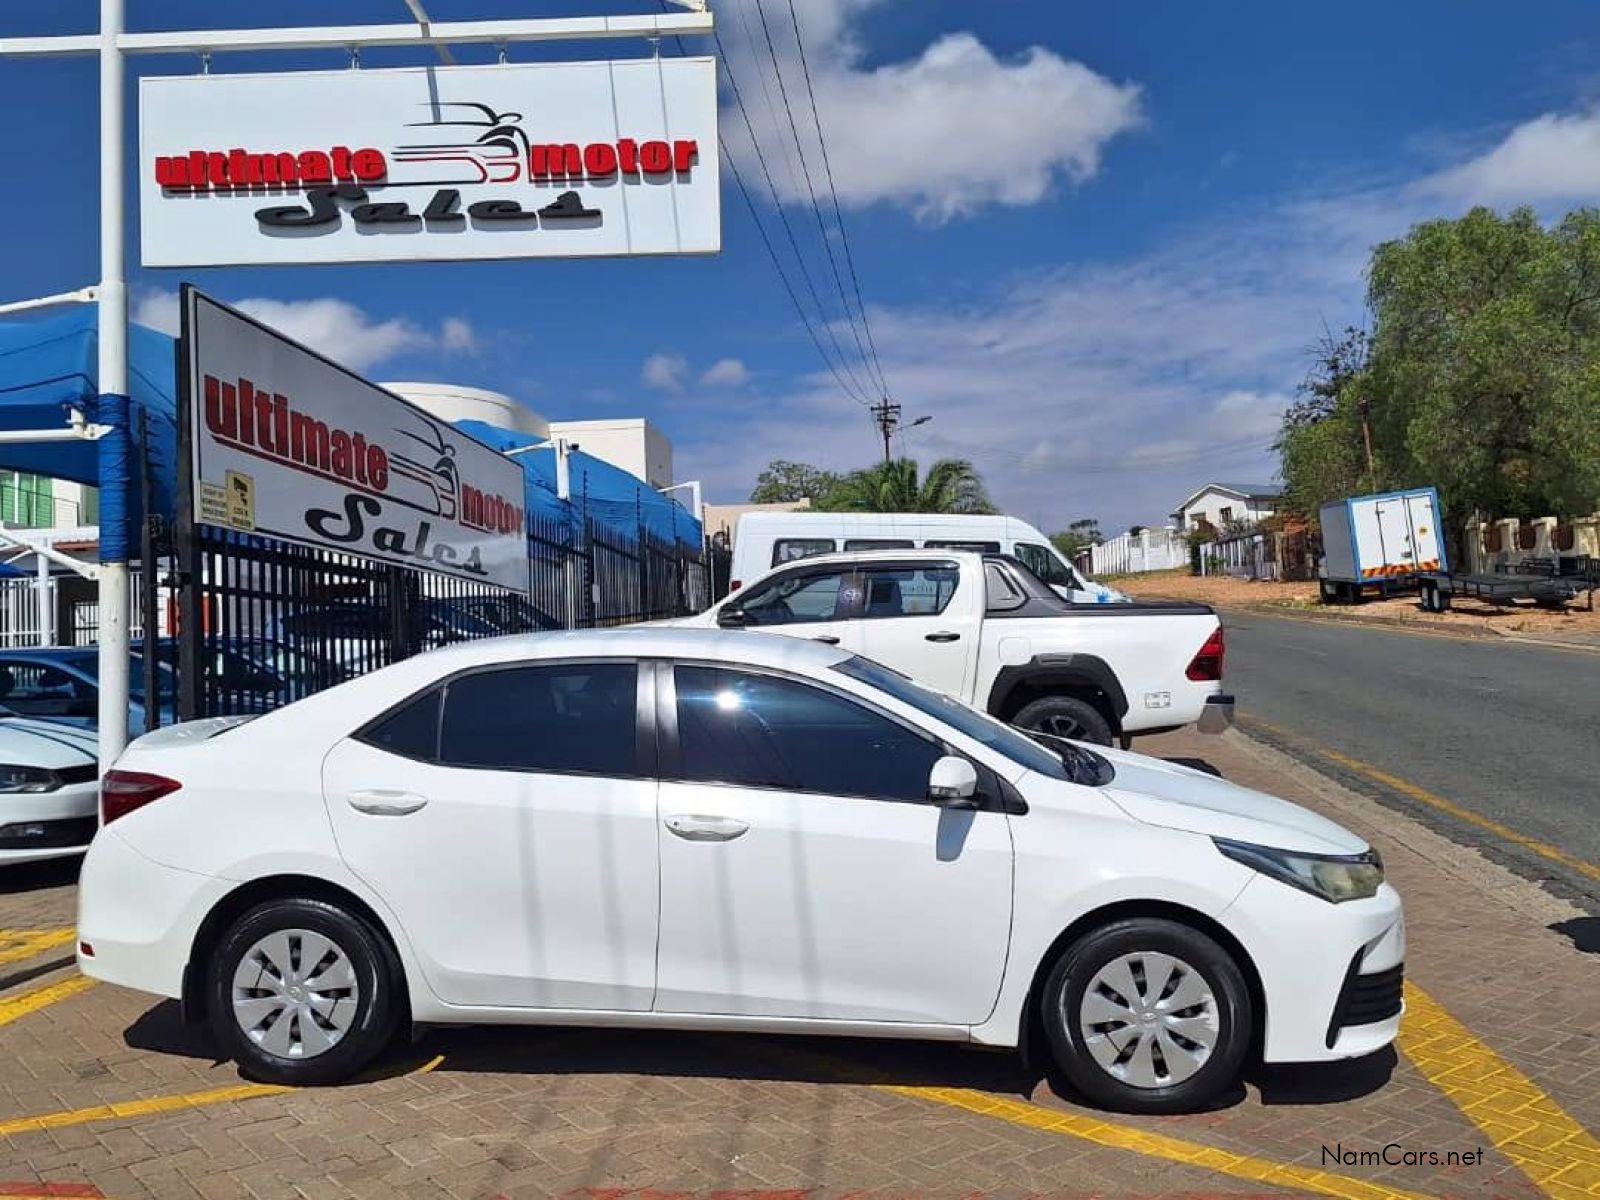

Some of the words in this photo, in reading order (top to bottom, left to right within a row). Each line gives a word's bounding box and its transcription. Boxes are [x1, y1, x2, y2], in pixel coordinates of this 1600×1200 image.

[155, 146, 387, 187] ultimate
[531, 138, 698, 176] motor
[254, 188, 602, 227] Sales
[204, 374, 388, 492] ultimate
[462, 482, 523, 534] motor
[304, 494, 488, 575] Sales
